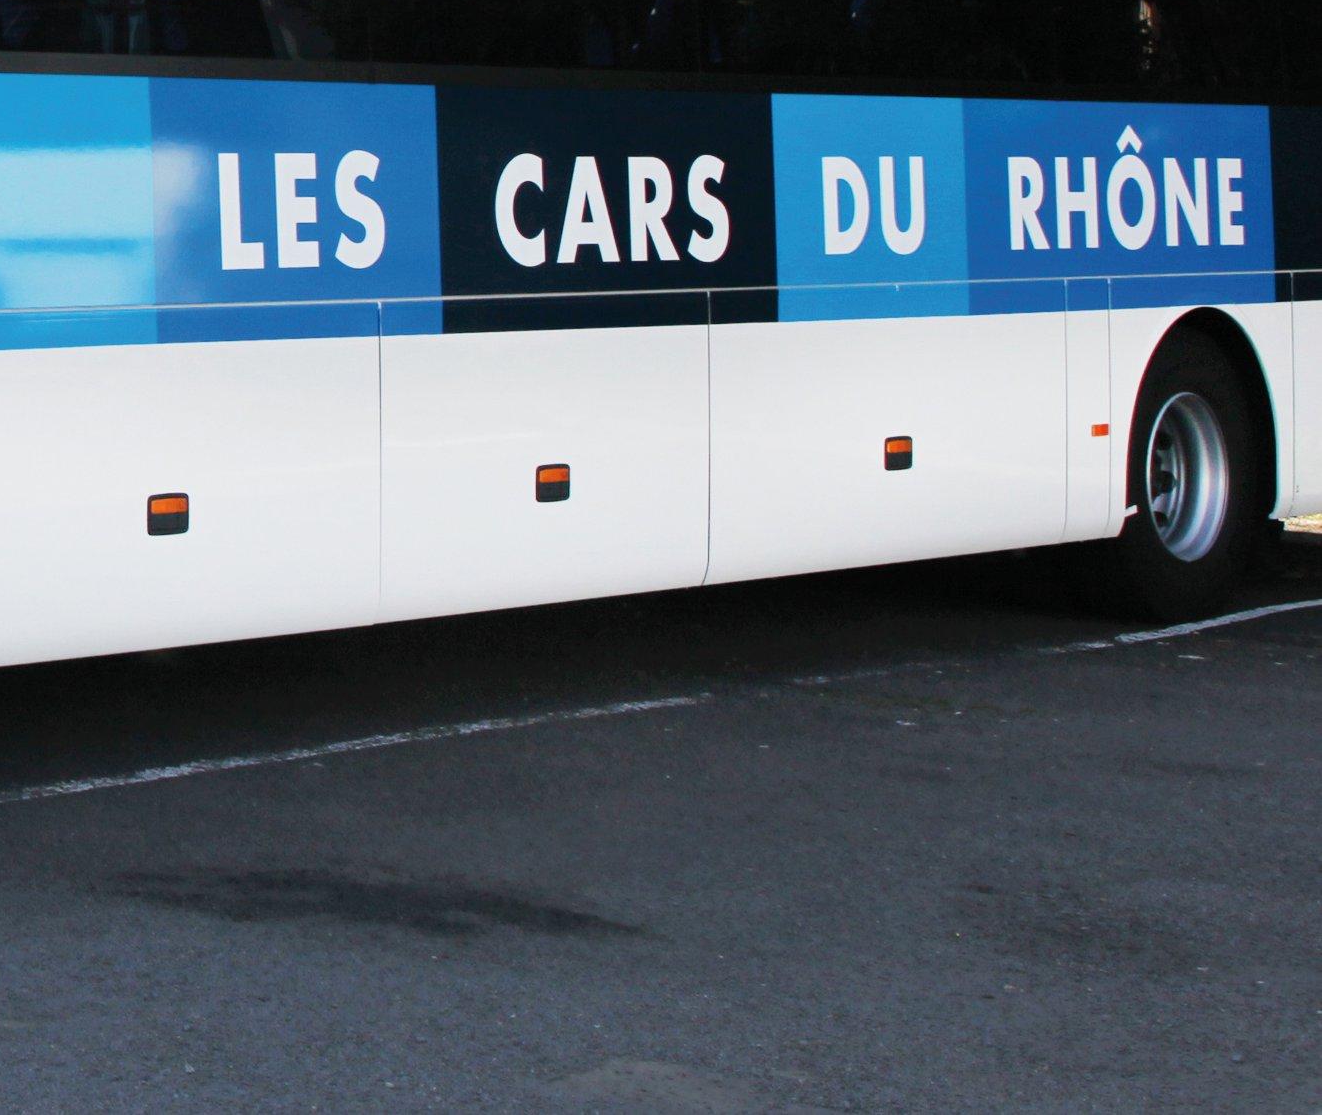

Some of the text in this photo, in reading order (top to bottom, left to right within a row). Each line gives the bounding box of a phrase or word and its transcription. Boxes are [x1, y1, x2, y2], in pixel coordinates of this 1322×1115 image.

[218, 124, 1245, 270] LES CARS DU RHÔNE
